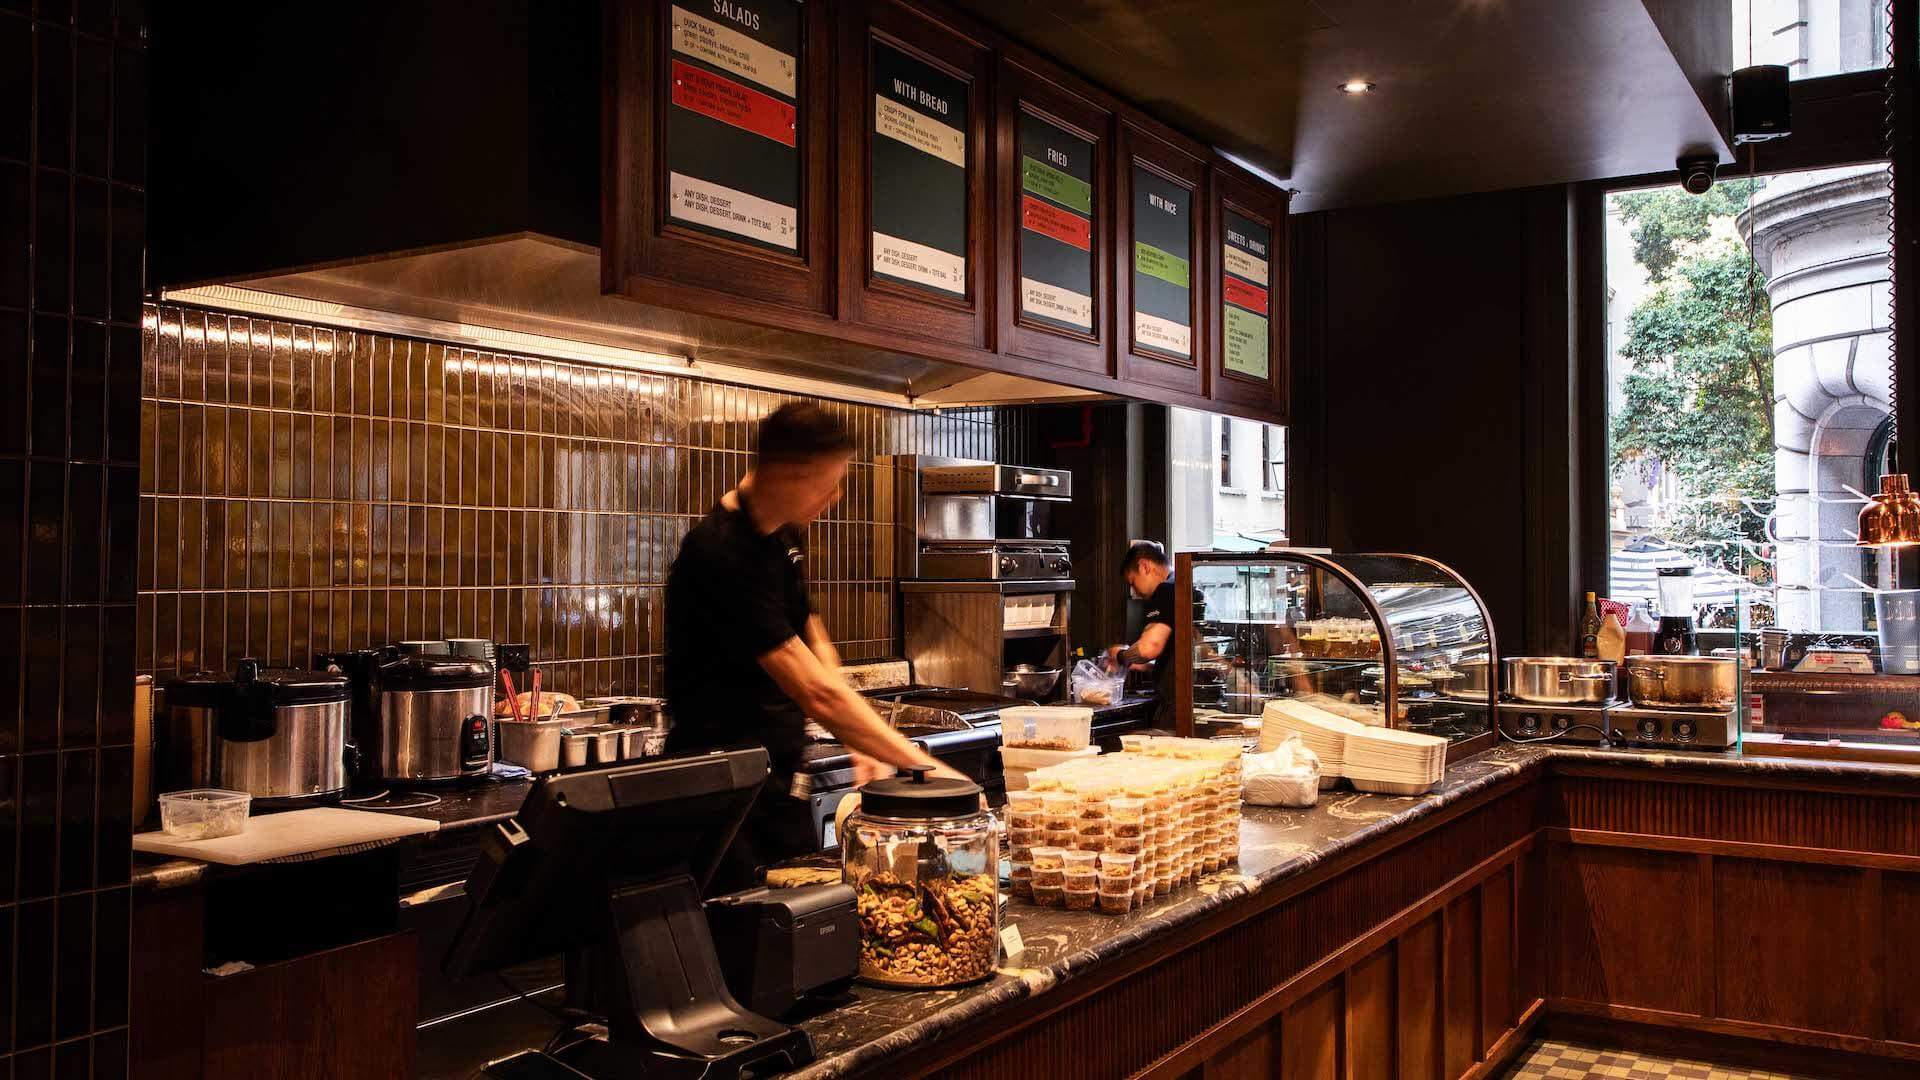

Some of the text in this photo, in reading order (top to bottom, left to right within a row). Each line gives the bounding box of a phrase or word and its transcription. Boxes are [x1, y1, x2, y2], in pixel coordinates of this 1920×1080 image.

[714, 0, 760, 30] SALADS
[894, 78, 948, 115] WITH BREAD
[1047, 148, 1067, 167] FRIED
[685, 189, 695, 200] ANY
[710, 196, 732, 208] DESSERT
[1149, 194, 1177, 215] WITH RICE
[684, 200, 695, 210] ANY
[732, 212, 746, 223] DRINK
[1227, 230, 1245, 246] SWEETS
